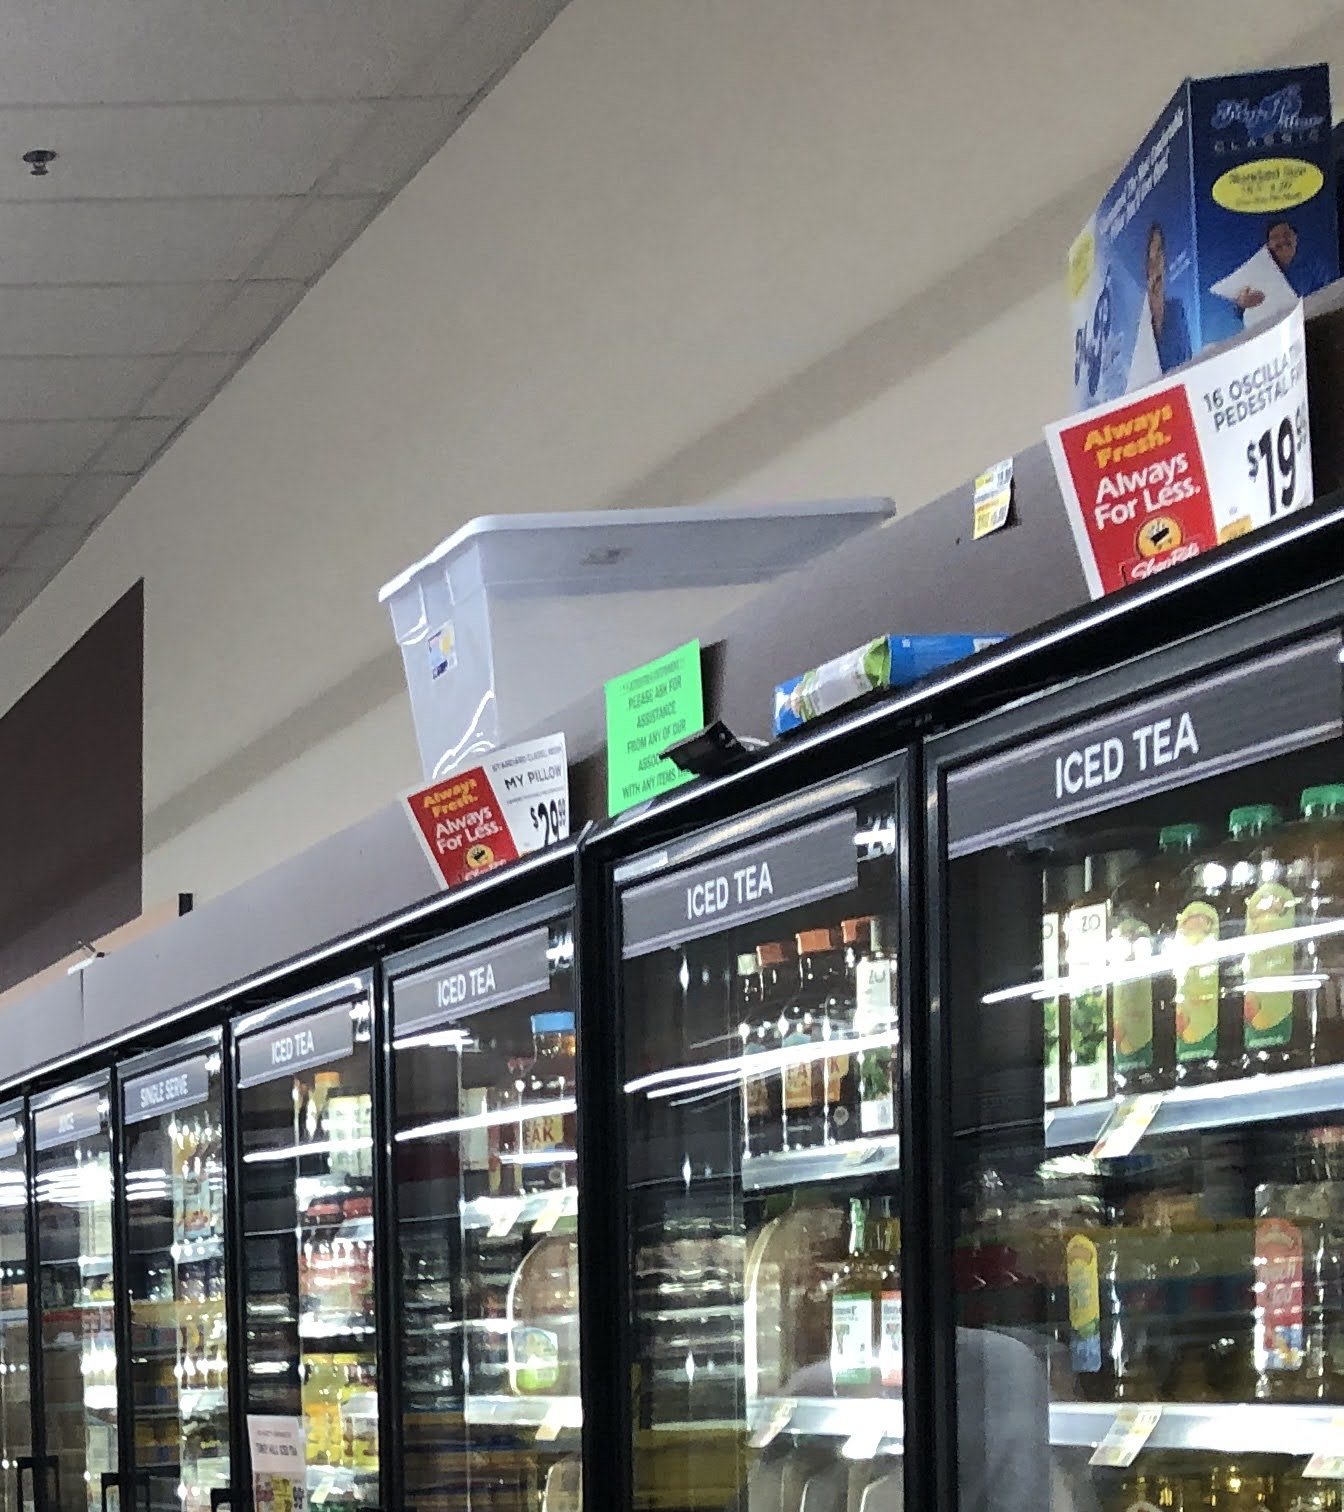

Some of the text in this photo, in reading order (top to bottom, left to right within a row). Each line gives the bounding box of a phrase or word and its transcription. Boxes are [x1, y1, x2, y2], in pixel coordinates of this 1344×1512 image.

[1203, 387, 1224, 413] 16
[1214, 385, 1289, 432] PEDESTAL
[1084, 404, 1173, 452] Always
[1096, 452, 1188, 505] Always
[1094, 477, 1202, 530] For Less.
[669, 675, 682, 692] FOR
[637, 701, 676, 729] ASSISTANCE
[627, 738, 647, 754] FROM
[648, 731, 663, 747] ANY
[672, 718, 687, 736] OUR
[1054, 712, 1200, 800] ICED TEA
[504, 764, 562, 790] MY PILLOW
[622, 784, 641, 799] WITH
[641, 778, 656, 794] ANY
[656, 770, 676, 789] ITEMS
[436, 806, 493, 839] Always
[436, 820, 503, 855] For Less.
[686, 861, 774, 919] ICED TEA
[437, 964, 496, 1007] ICED TEA
[271, 1030, 315, 1065] ICED TEA
[140, 1073, 189, 1108] SINGLE SERVE
